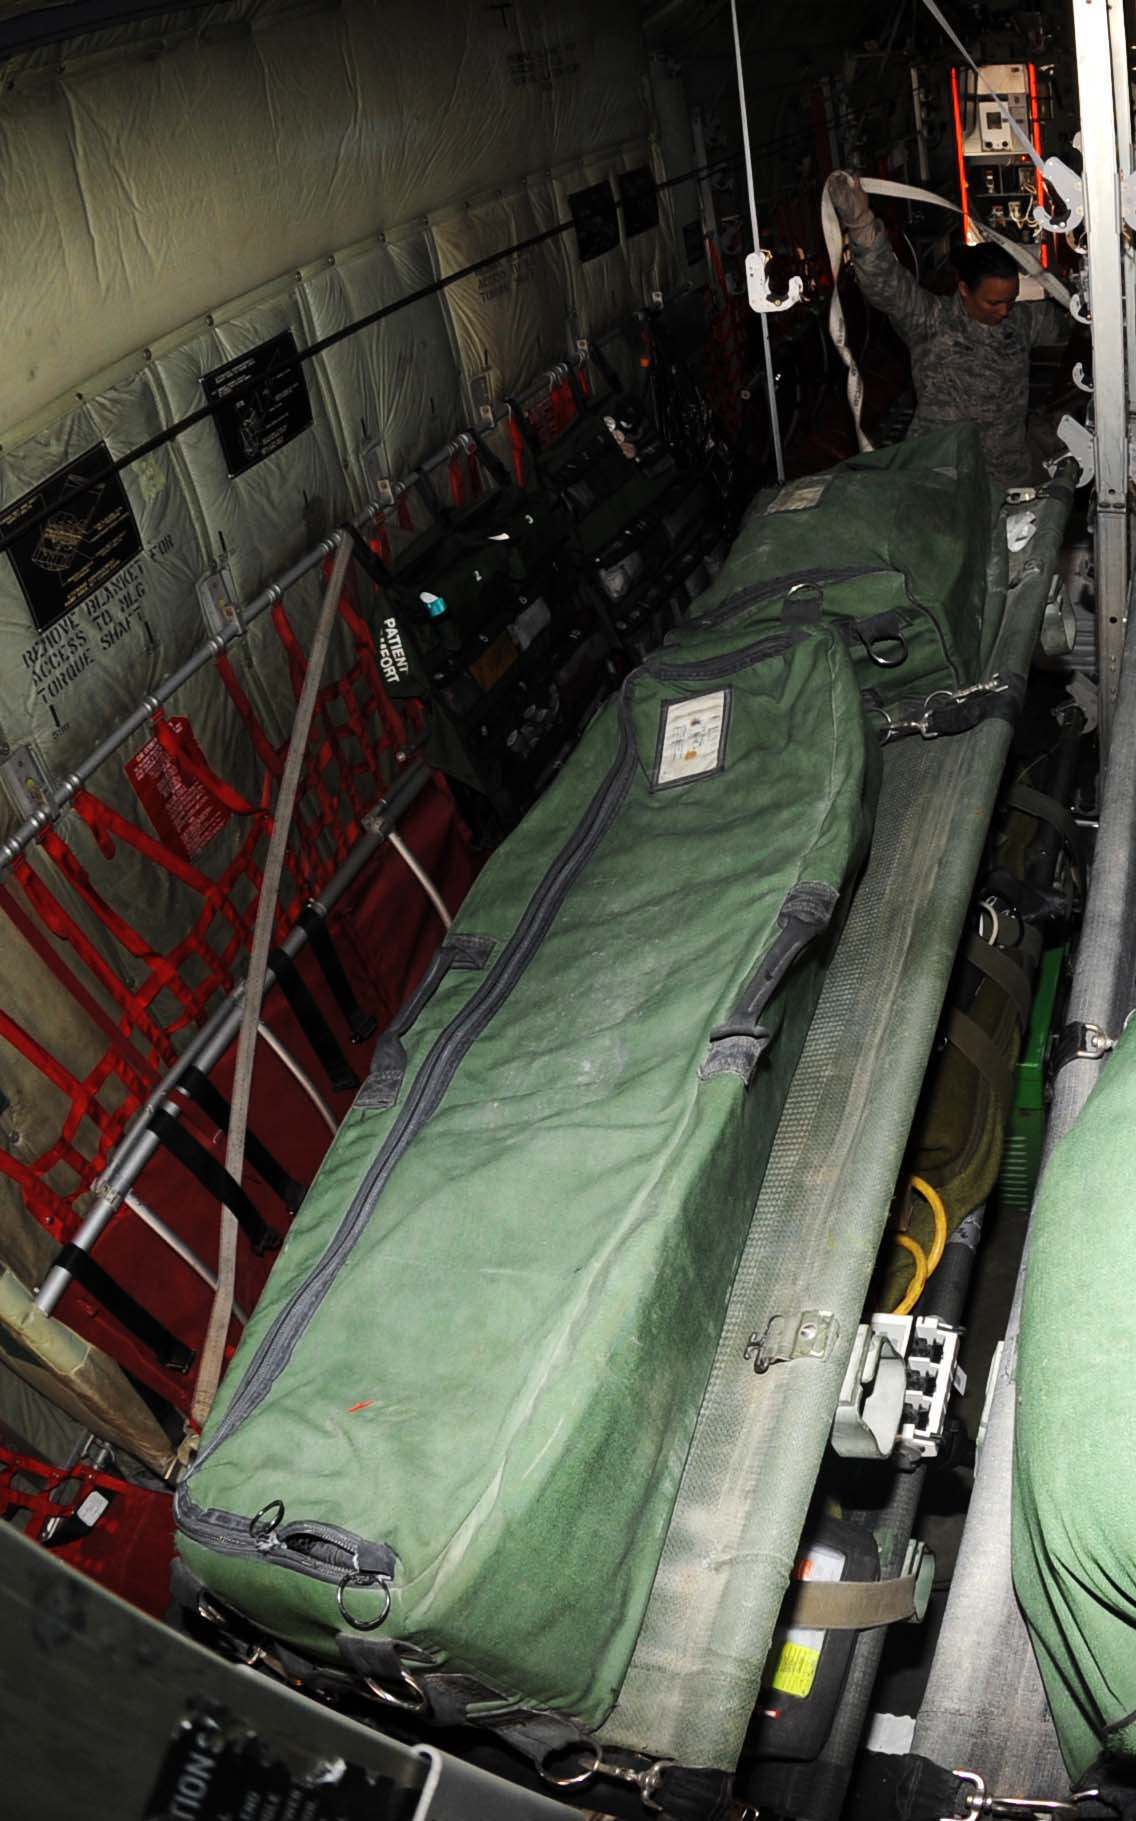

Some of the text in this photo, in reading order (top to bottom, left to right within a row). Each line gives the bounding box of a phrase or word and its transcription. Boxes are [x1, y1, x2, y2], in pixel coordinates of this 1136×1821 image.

[22, 611, 80, 669] REMOVE
[85, 564, 146, 617] BLANKET
[151, 534, 174, 560] FOR
[33, 630, 87, 687] ACCESS
[92, 609, 114, 632] TO
[119, 582, 146, 615] MLG
[383, 616, 409, 676] PATIENT
[37, 606, 145, 703] TORQUE SHAFT
[379, 634, 401, 683] FORT
